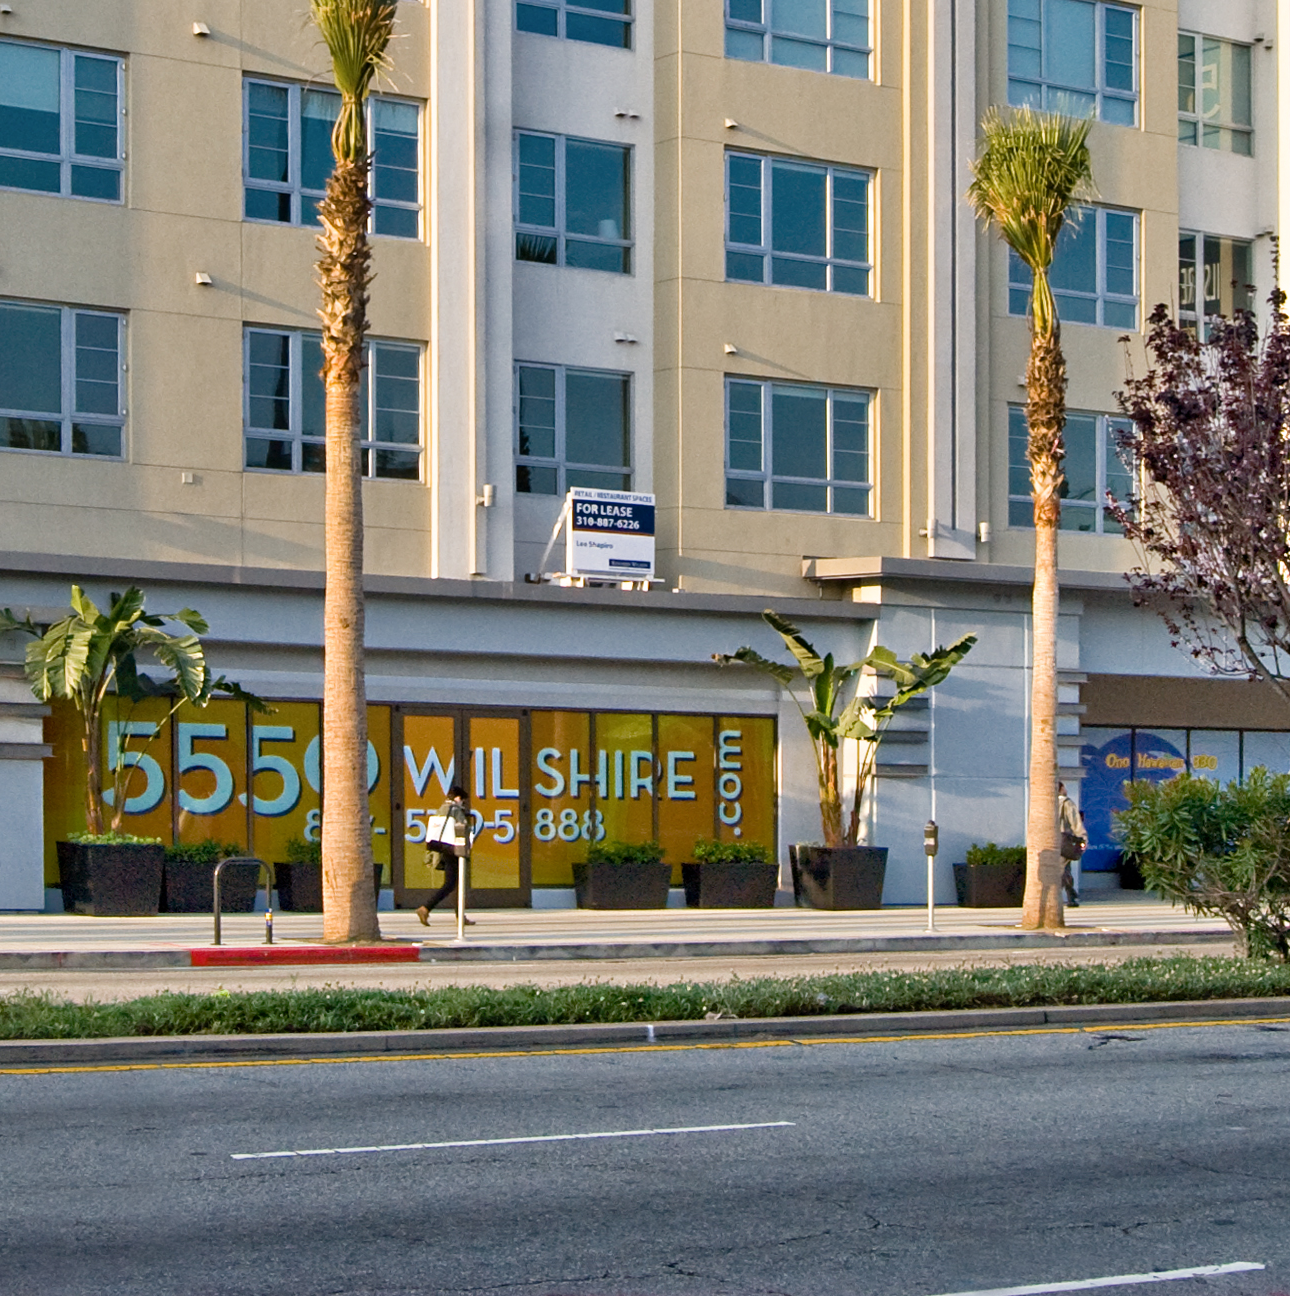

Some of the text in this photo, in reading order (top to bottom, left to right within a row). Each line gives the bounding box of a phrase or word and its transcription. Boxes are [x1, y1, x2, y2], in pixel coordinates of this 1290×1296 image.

[576, 503, 633, 517] FOR LEASE
[718, 729, 744, 837] .com
